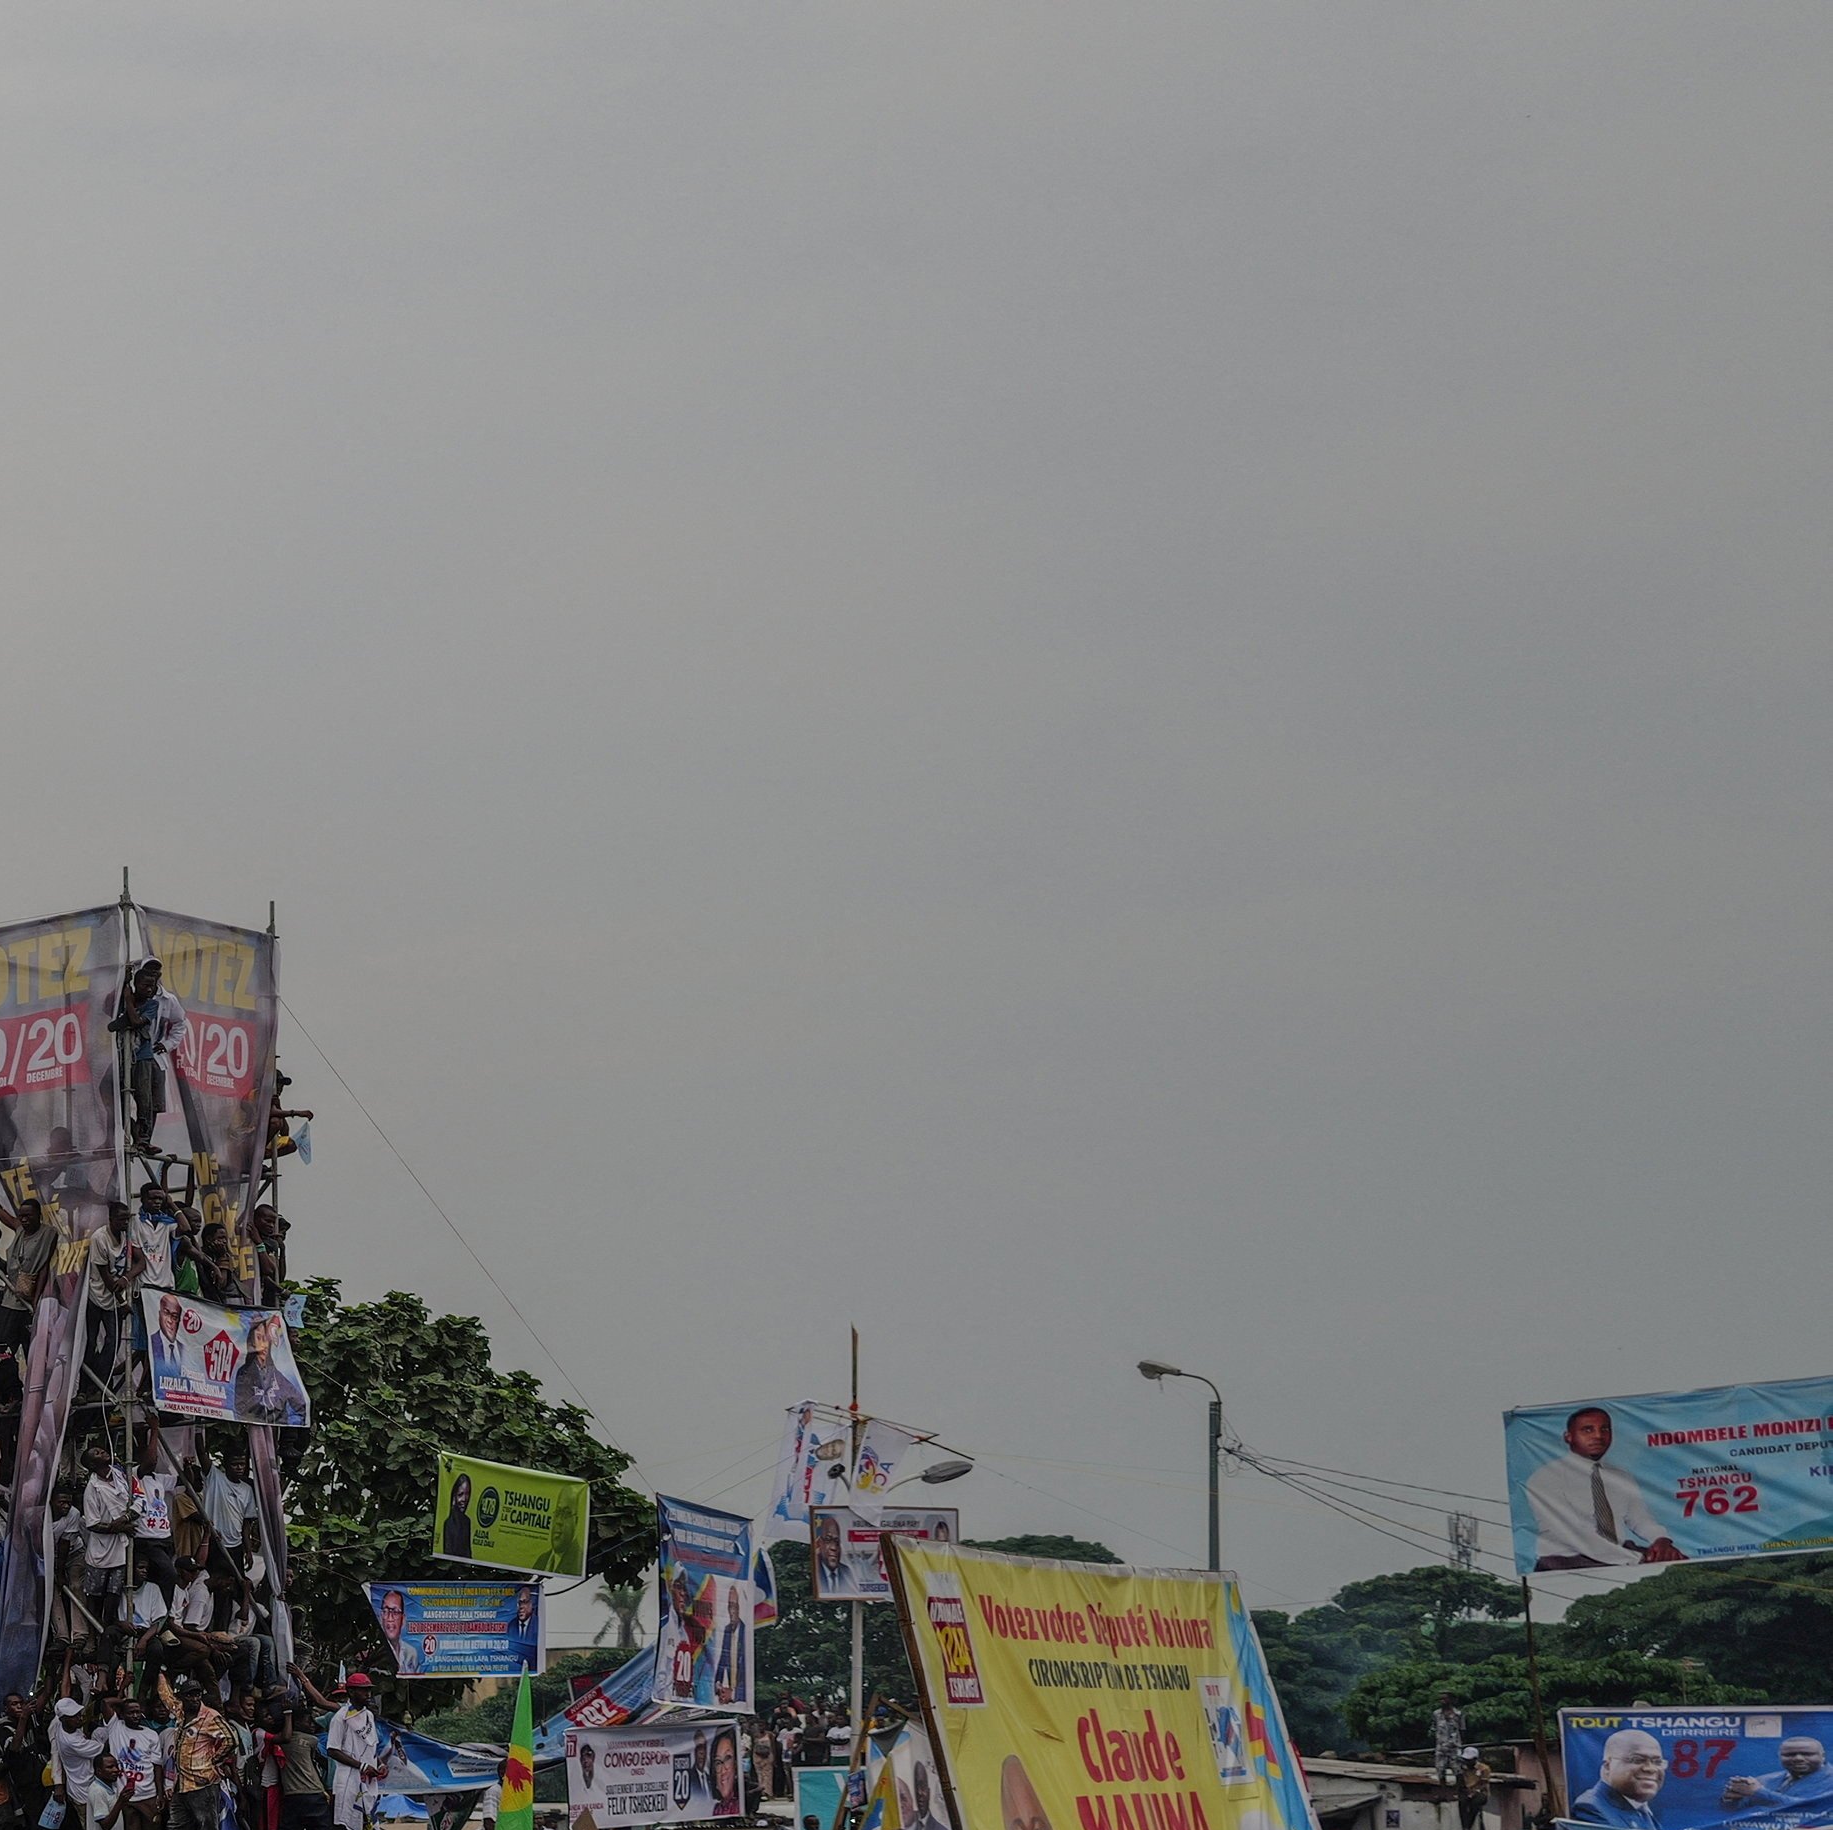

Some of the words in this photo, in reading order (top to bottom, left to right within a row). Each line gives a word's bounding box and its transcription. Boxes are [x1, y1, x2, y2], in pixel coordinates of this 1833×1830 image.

[1647, 1425, 1747, 1447] NDOMBELE
[1753, 1417, 1821, 1437] MONIZI
[1729, 1444, 1791, 1457] CANDIDAT
[1692, 1464, 1740, 1475] NATIONAL
[1677, 1473, 1752, 1489] TSHANGU
[504, 1490, 550, 1512] TSHANGU
[1676, 1485, 1759, 1518] 762
[510, 1510, 551, 1530] CAPITALE
[1568, 1717, 1622, 1729] TOUT
[1627, 1717, 1741, 1729] TSHANGU
[1077, 1708, 1186, 1784] Claude
[604, 1752, 639, 1768] CONGO
[1671, 1739, 1736, 1780] 87
[674, 1770, 689, 1800] 20
